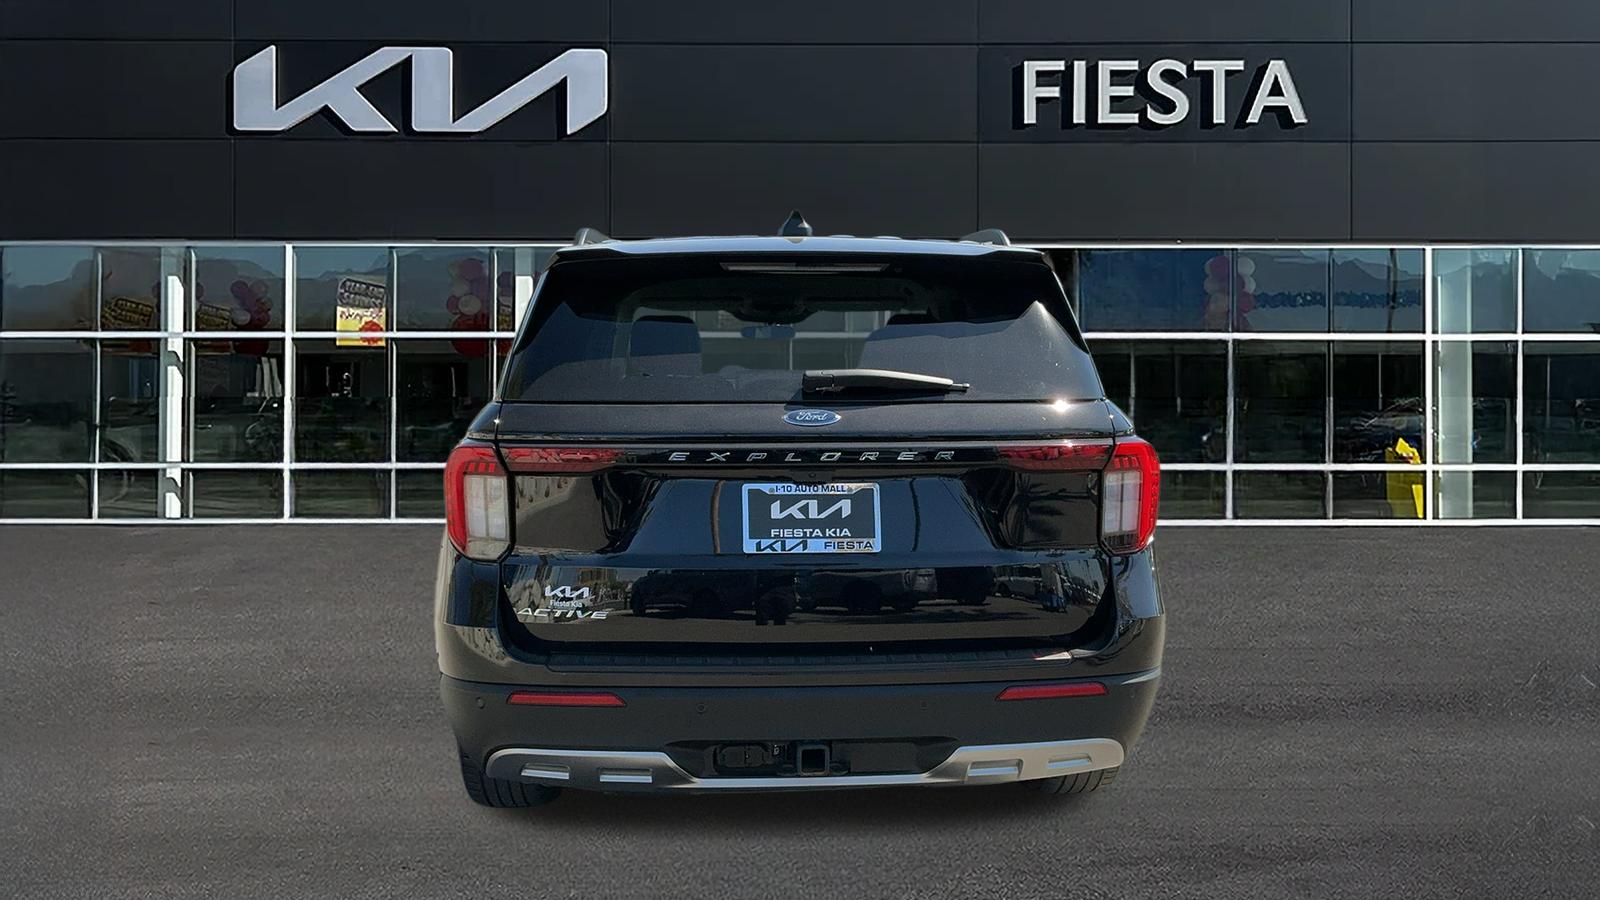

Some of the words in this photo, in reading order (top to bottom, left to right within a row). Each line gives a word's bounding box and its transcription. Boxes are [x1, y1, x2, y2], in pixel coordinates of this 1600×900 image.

[233, 44, 609, 136] KIA
[1023, 58, 1309, 125] FIESTA
[795, 410, 829, 421] Ford
[667, 450, 955, 463] EXPLORER
[775, 485, 793, 493] I-10
[794, 485, 819, 493] AUTO
[820, 485, 846, 494] MALL
[770, 498, 852, 520] KIA
[770, 528, 823, 538] FIESTA
[825, 528, 852, 537] KIA
[755, 539, 808, 552] KIA
[824, 541, 873, 550] FIESTA
[544, 585, 590, 598] KIA
[517, 607, 609, 620] ACTIVE
